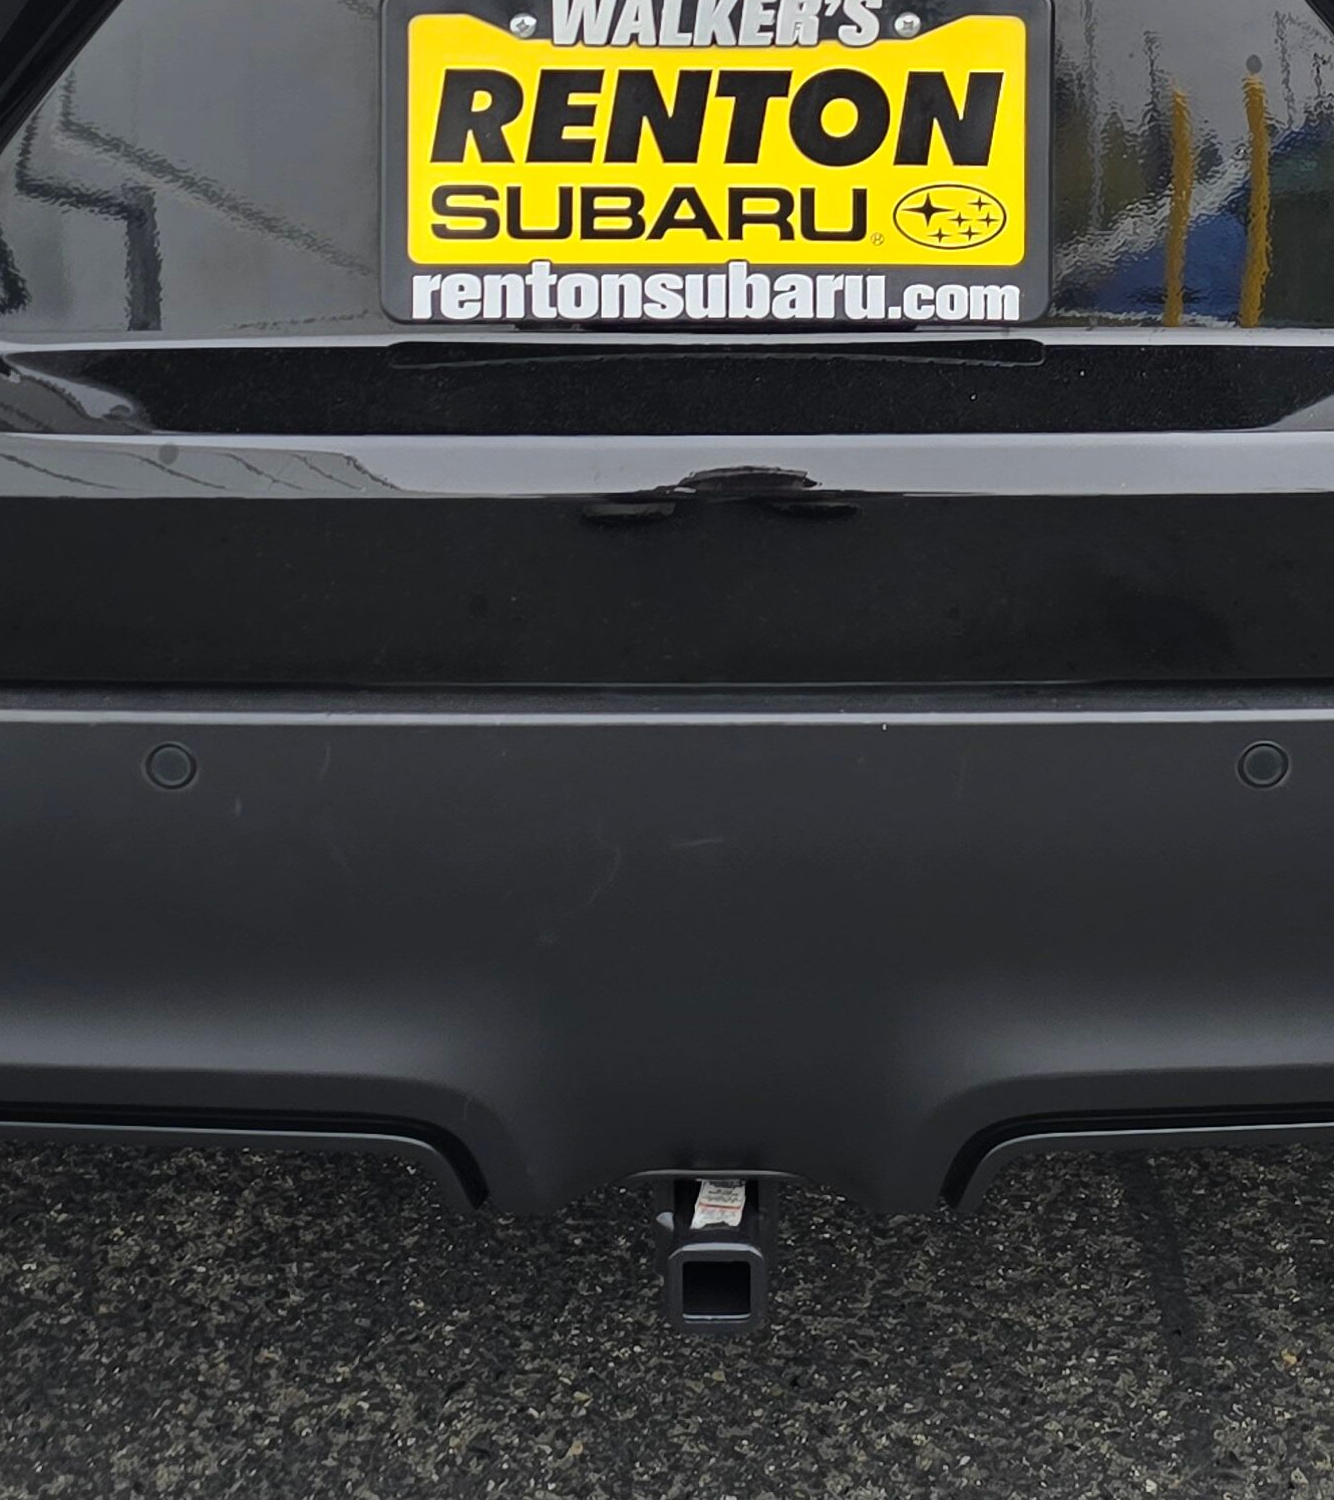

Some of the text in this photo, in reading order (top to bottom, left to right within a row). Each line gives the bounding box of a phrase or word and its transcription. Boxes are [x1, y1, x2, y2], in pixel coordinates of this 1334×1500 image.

[429, 68, 1005, 167] RENTON
[430, 185, 867, 241] SUBARU
[410, 260, 1021, 320] rentonsubaru.com
